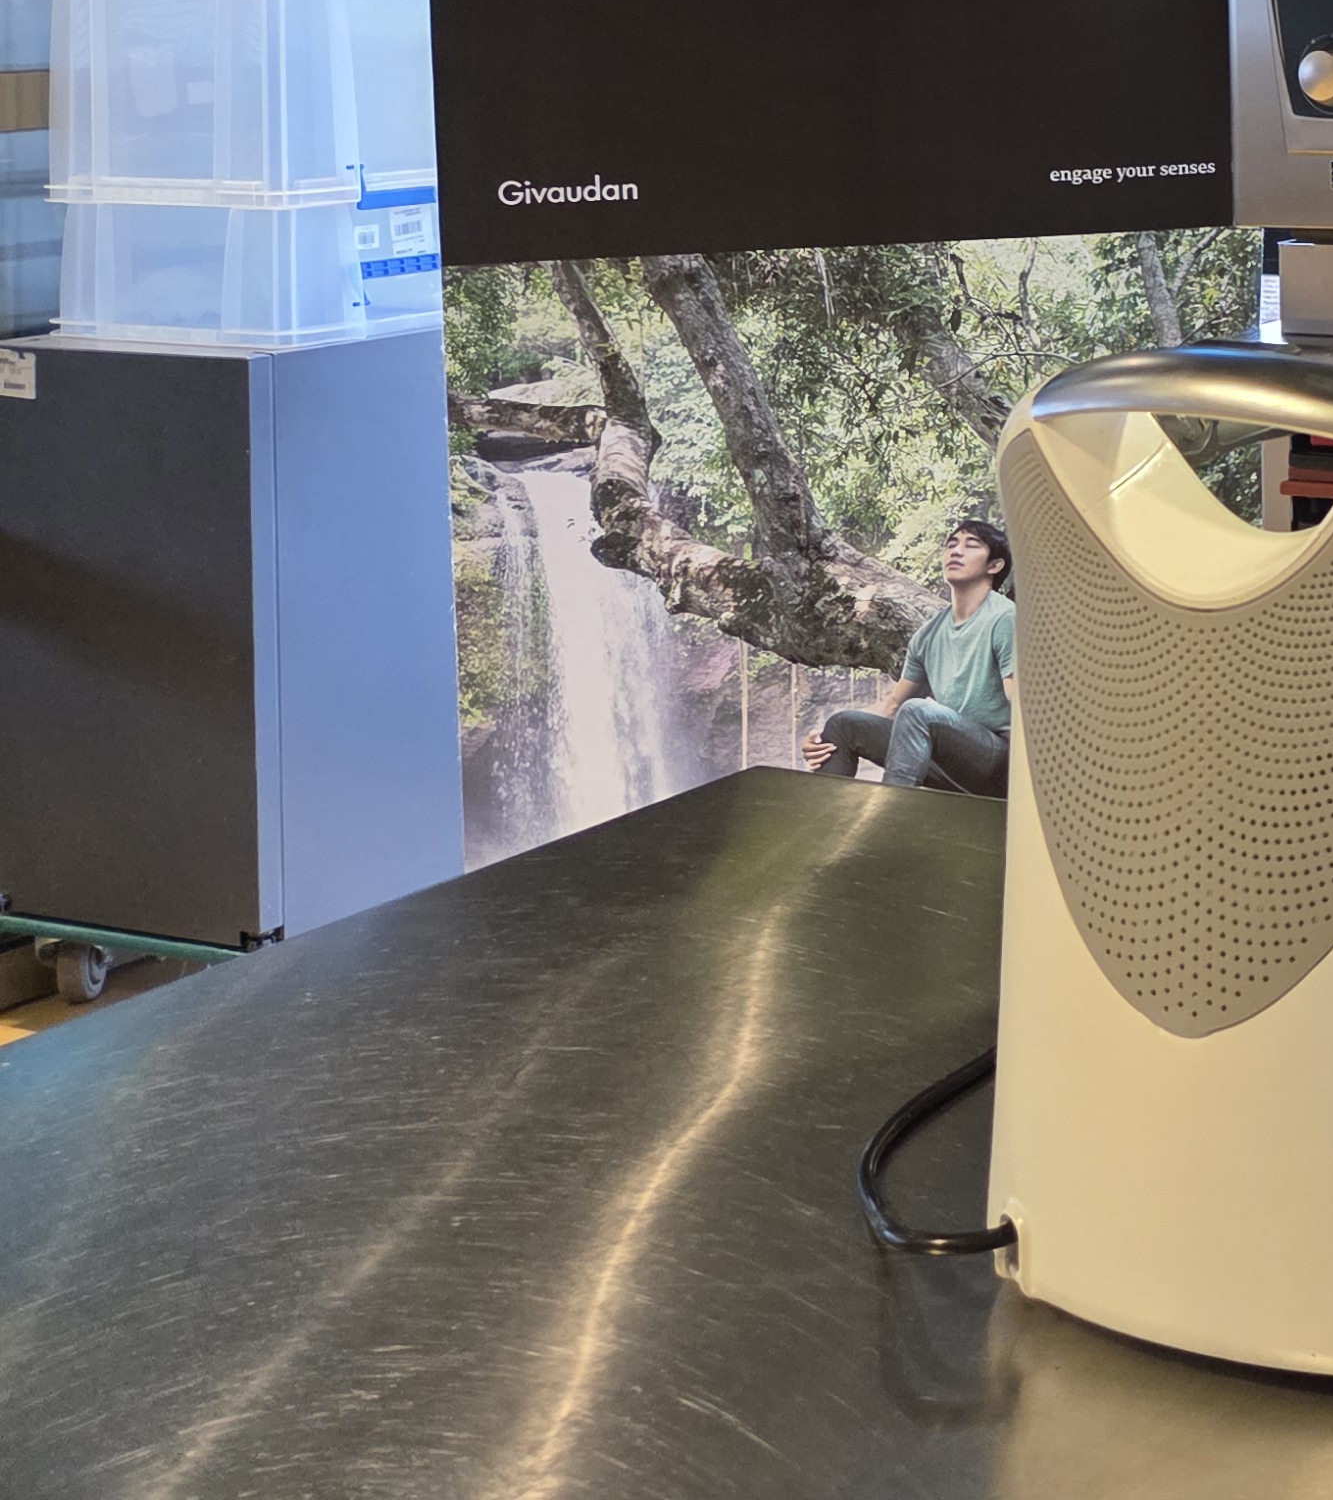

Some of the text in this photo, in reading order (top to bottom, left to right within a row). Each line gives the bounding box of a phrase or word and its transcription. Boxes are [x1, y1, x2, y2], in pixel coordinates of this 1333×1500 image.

[1049, 162, 1216, 185] engage your senses
[497, 174, 639, 206] Givaudan
